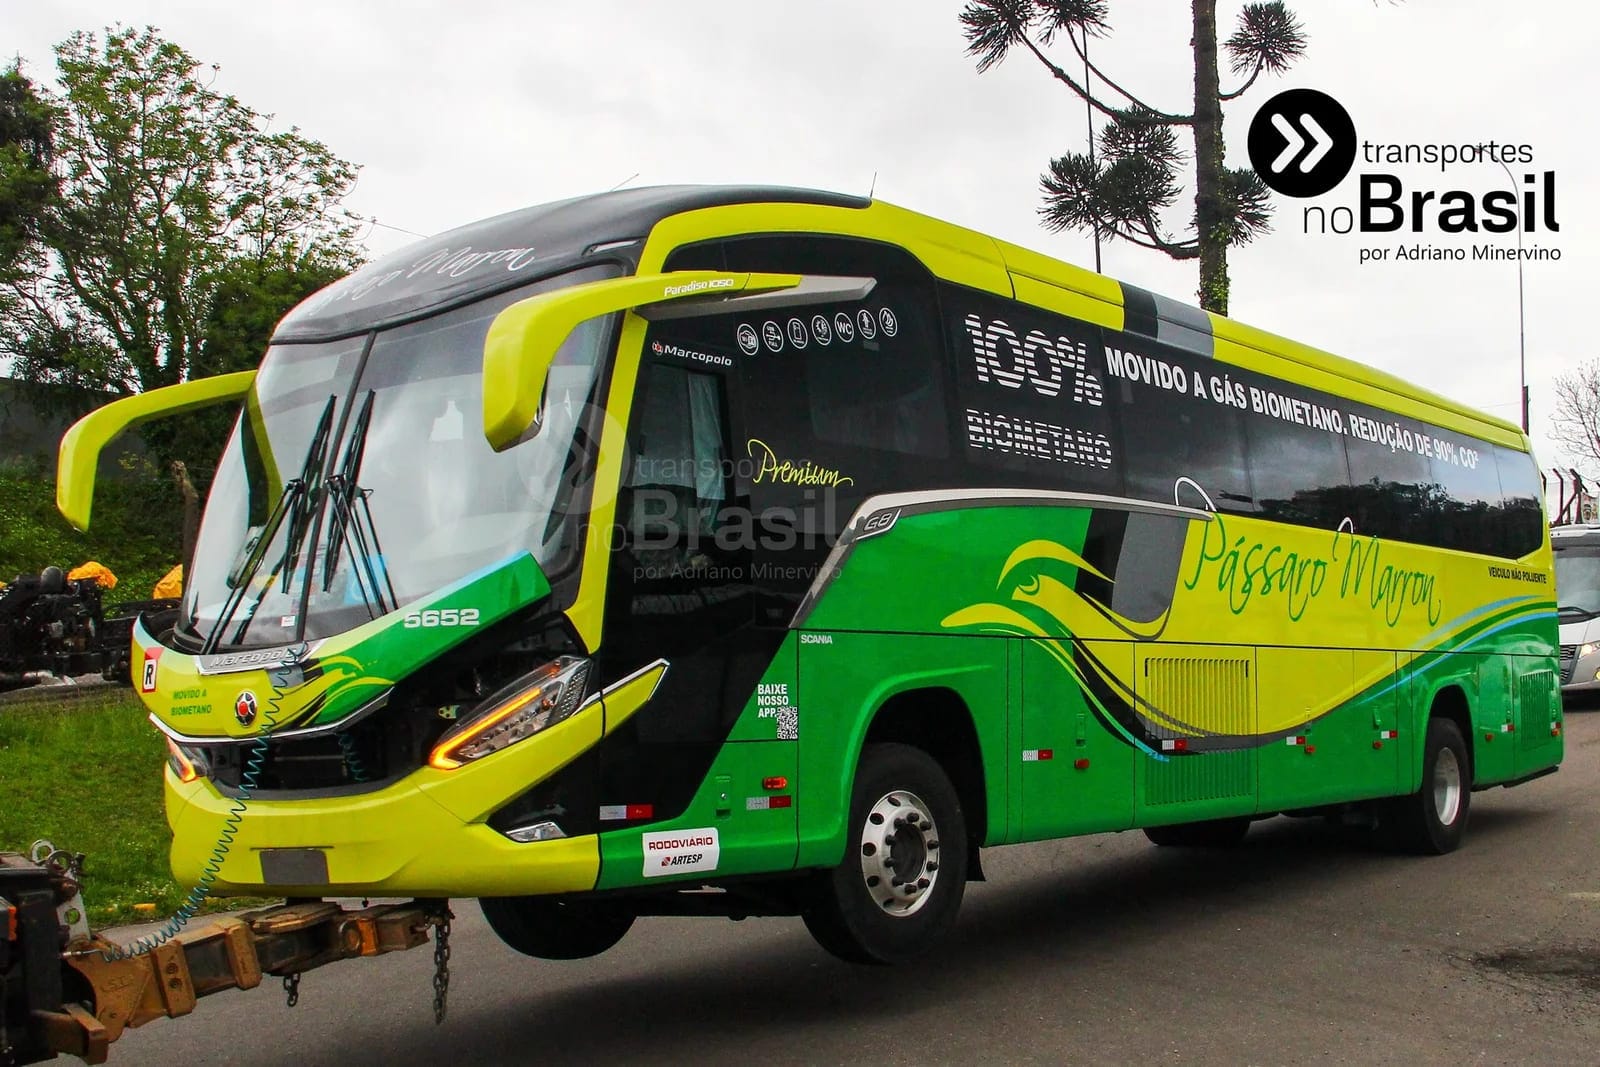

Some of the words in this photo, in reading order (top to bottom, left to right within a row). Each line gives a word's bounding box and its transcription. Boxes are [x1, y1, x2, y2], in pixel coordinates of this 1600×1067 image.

[664, 280, 708, 297] Paradiso
[836, 320, 853, 335] WC
[664, 344, 732, 366] Marcopolo
[964, 313, 1103, 406] 100%
[1104, 346, 1188, 394] MOVIDO
[1193, 371, 1208, 399] A
[1209, 374, 1247, 410] GÁS
[1250, 386, 1349, 435] BIOMETANO.
[1349, 413, 1414, 453] REDUÇÃO
[1414, 432, 1433, 458] DE
[1433, 438, 1459, 465] 90%
[966, 408, 1112, 469] BIOMETANO
[747, 439, 854, 488] Premium
[864, 513, 893, 530] G8
[1174, 476, 1328, 622] Pássaro
[1332, 516, 1442, 627] Marron
[1522, 570, 1547, 584] POLUENTE
[404, 608, 480, 628] 5652
[800, 634, 833, 645] SCANIA
[145, 664, 154, 685] R
[173, 690, 200, 700] MOVIDO
[757, 684, 788, 695] BAIXE
[757, 696, 789, 706] NOSSO
[171, 705, 212, 716] BIOMETANO
[649, 837, 713, 850] RODOVIÁRIO
[671, 853, 703, 867] ARTESP
